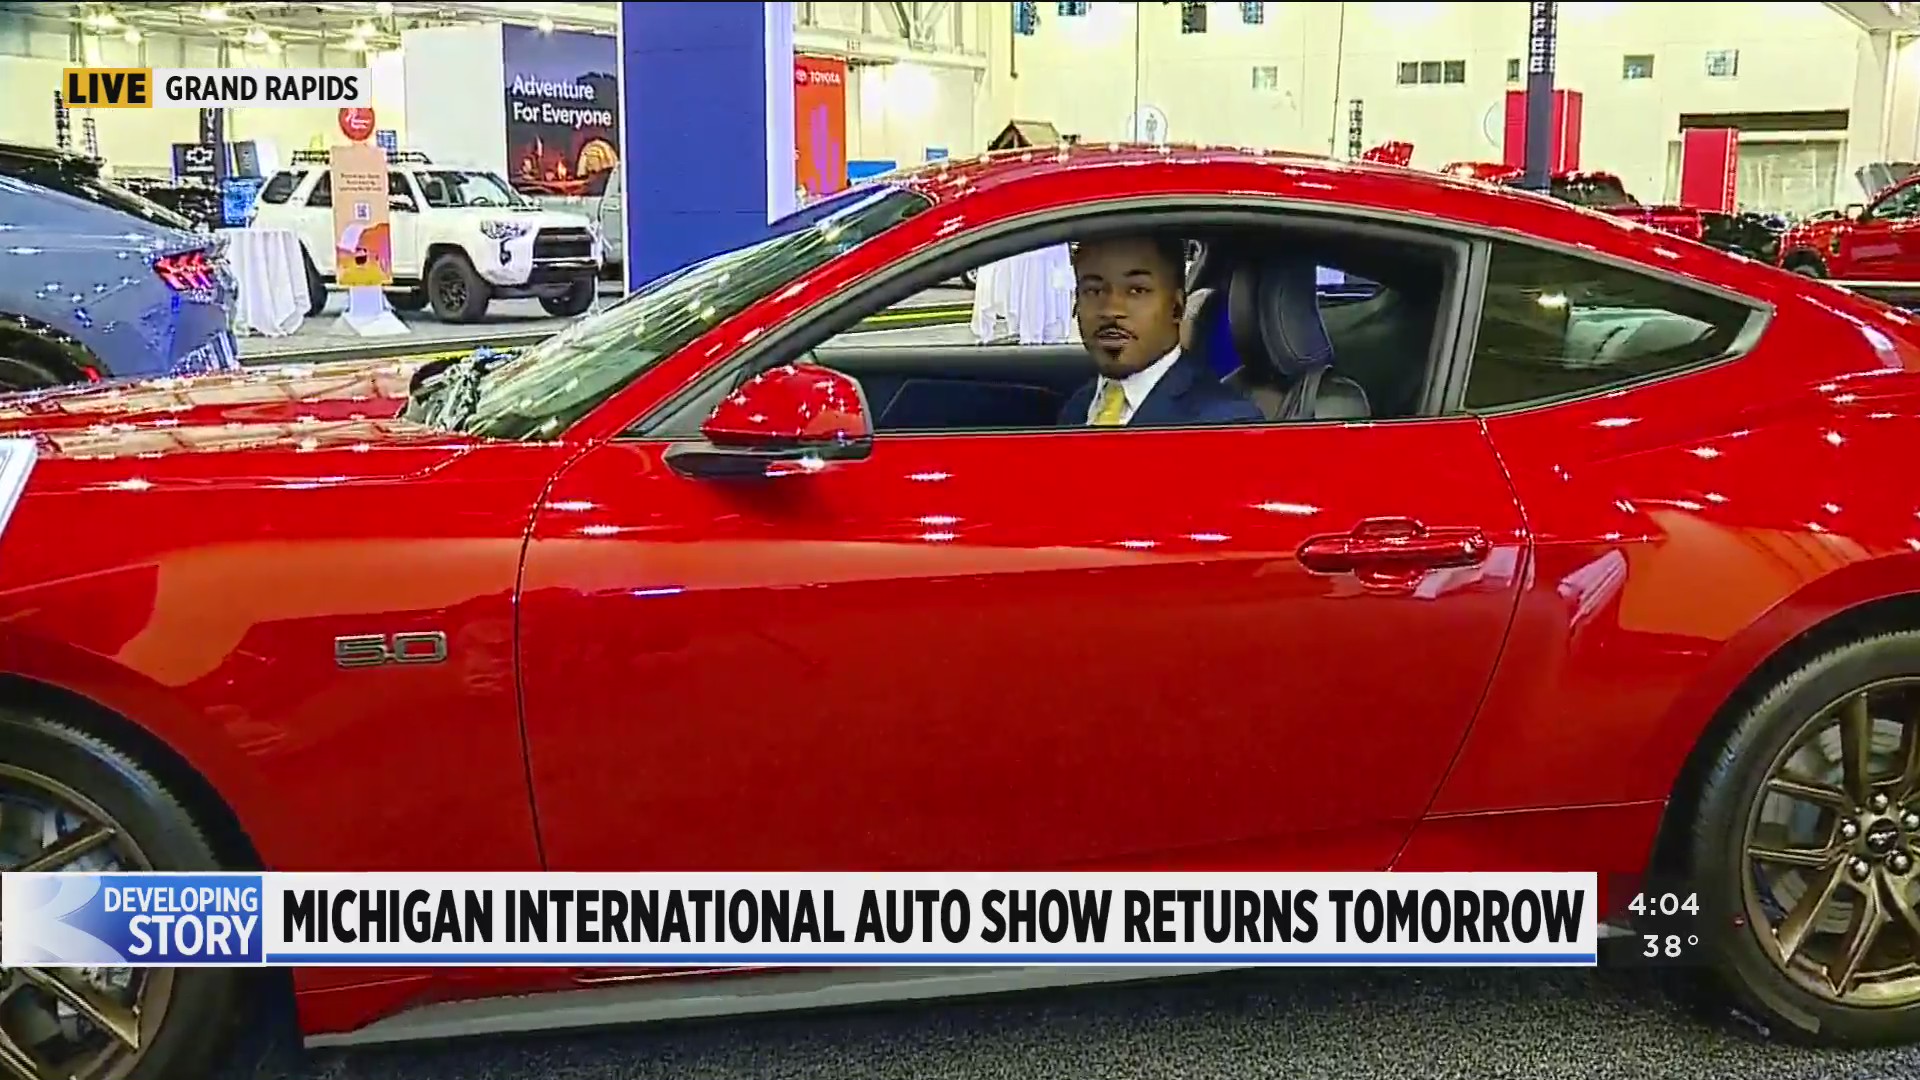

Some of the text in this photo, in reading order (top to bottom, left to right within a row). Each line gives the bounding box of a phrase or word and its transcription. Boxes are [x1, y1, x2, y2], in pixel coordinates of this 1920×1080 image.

[512, 73, 595, 100] Adventure
[513, 102, 612, 129] For Everyone
[335, 631, 447, 667] 5.0
